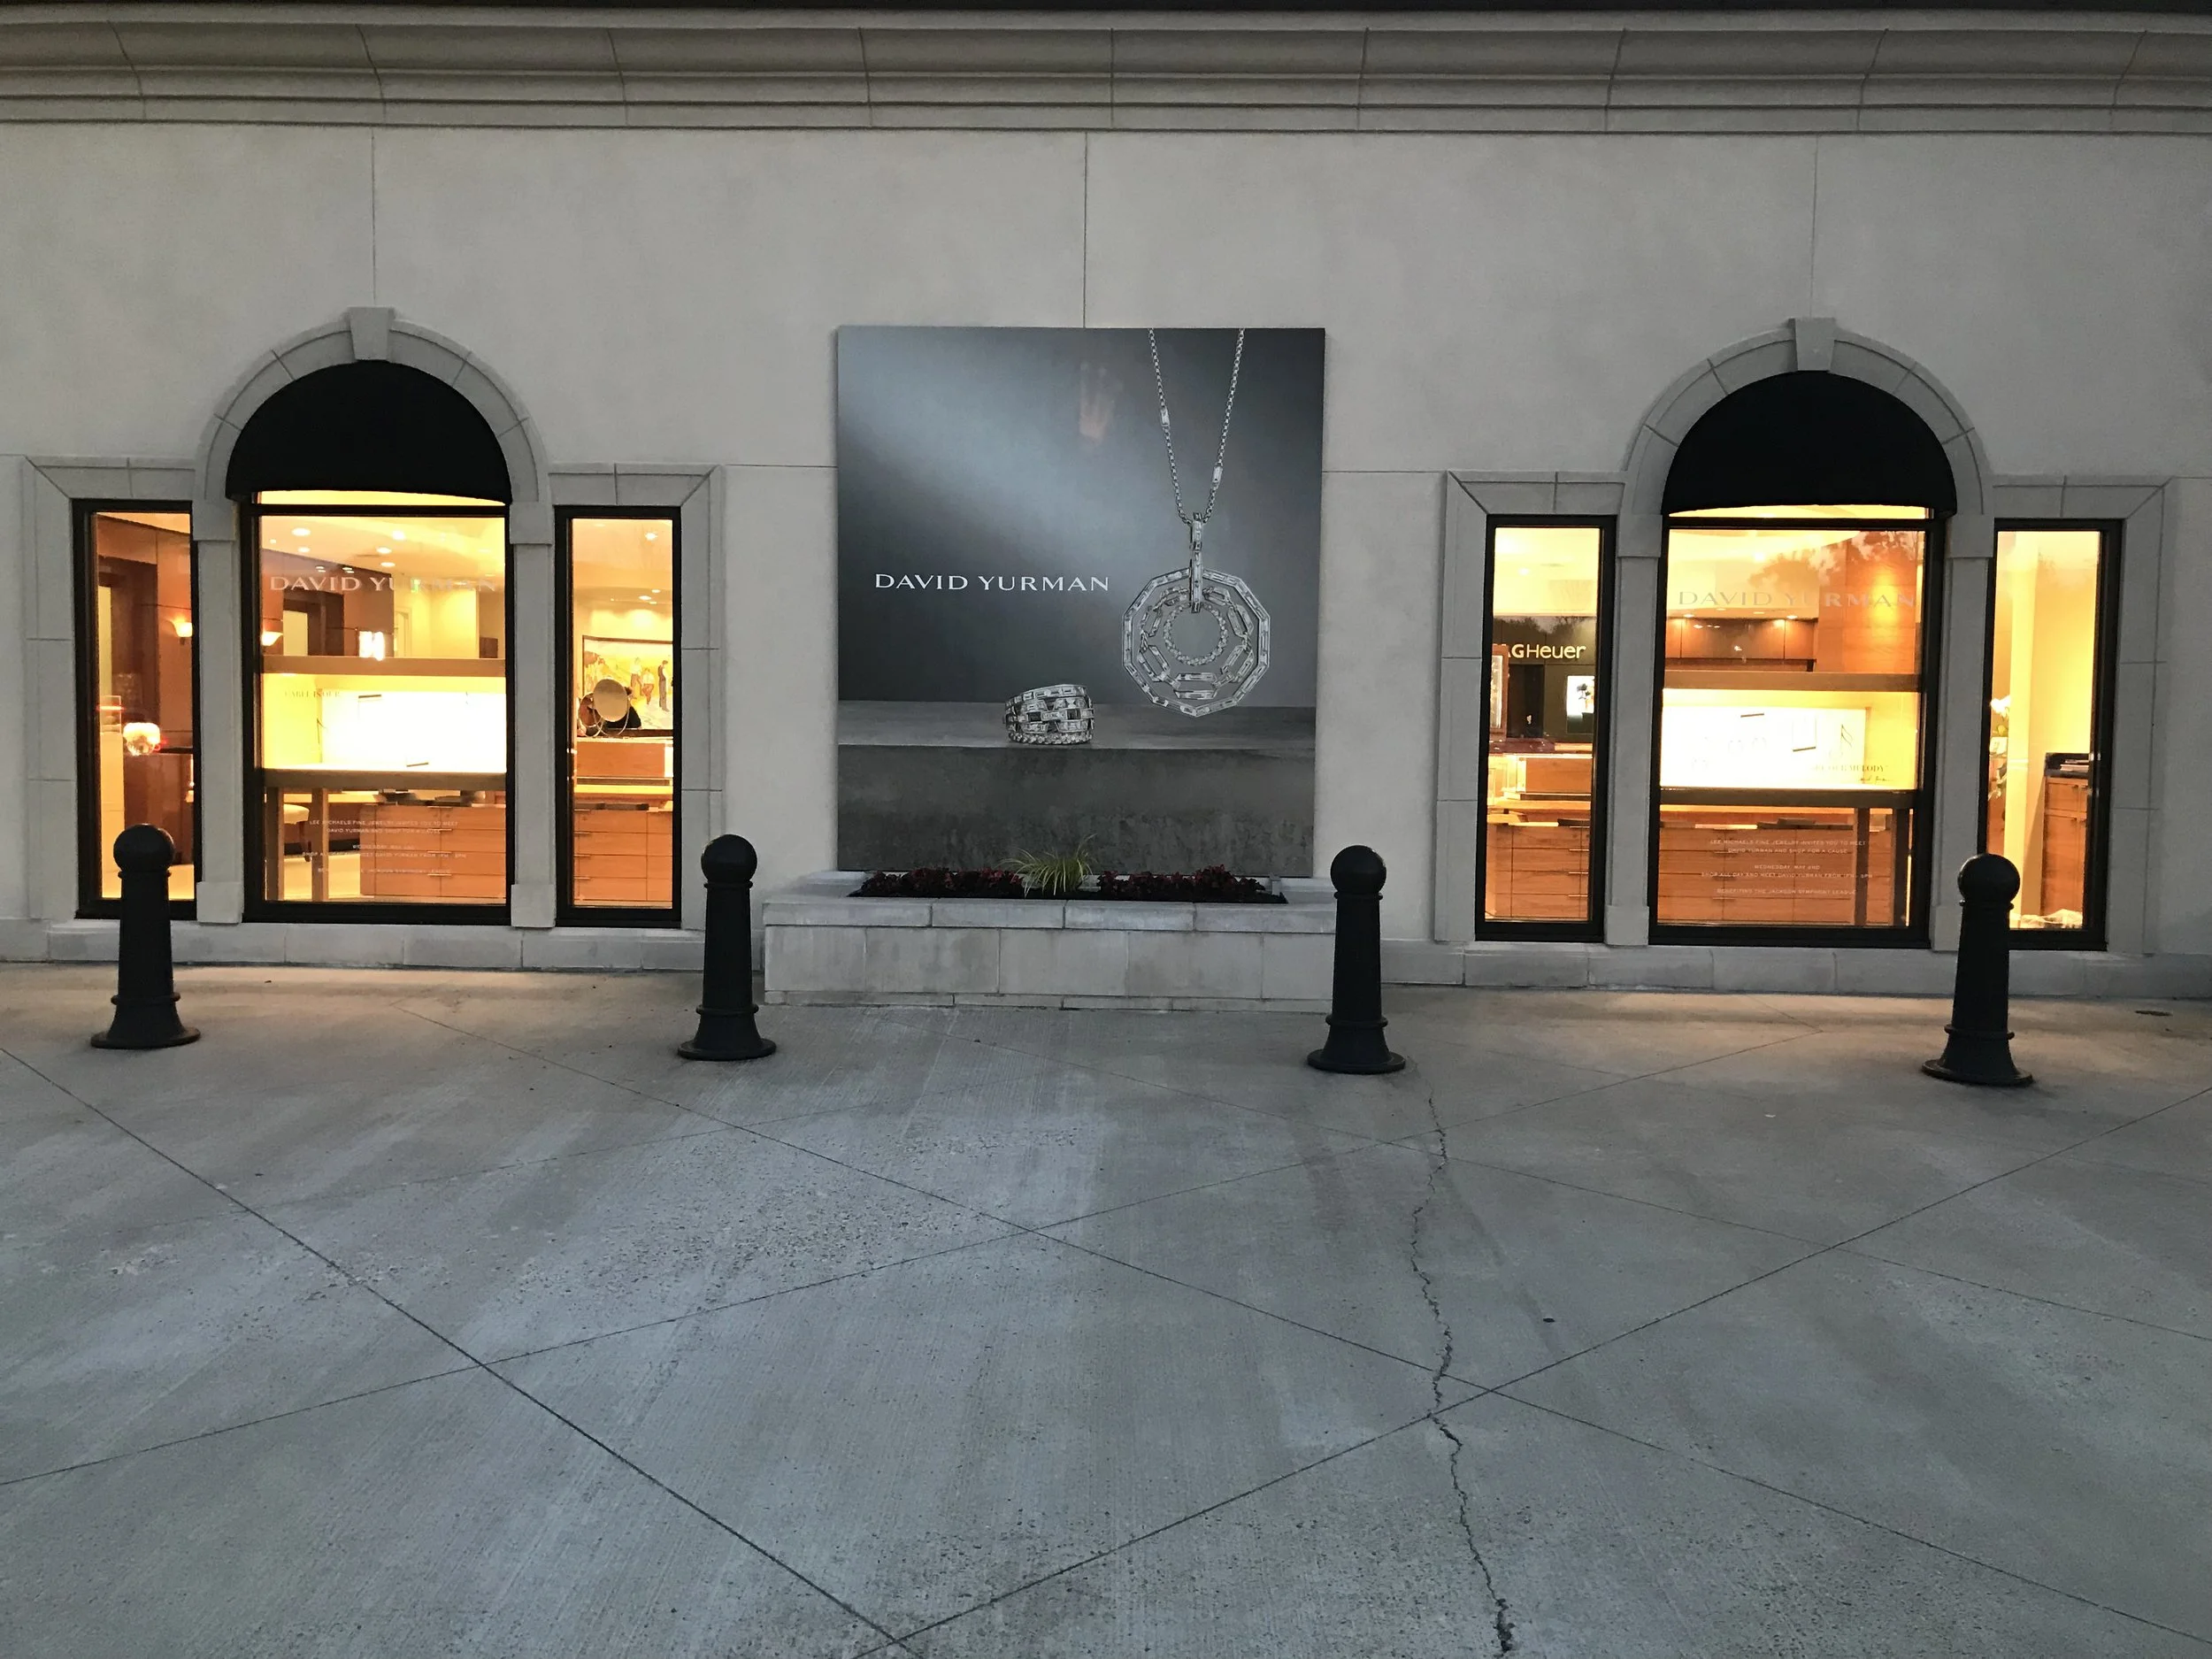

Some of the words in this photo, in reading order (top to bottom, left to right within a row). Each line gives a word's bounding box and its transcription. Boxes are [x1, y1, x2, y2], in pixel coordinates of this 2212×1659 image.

[270, 576, 361, 592] DAVID
[875, 573, 969, 590] DAVID
[978, 576, 1110, 591] YURMAN
[1678, 591, 1772, 606] DAVID
[1784, 592, 1915, 608] YURMAN
